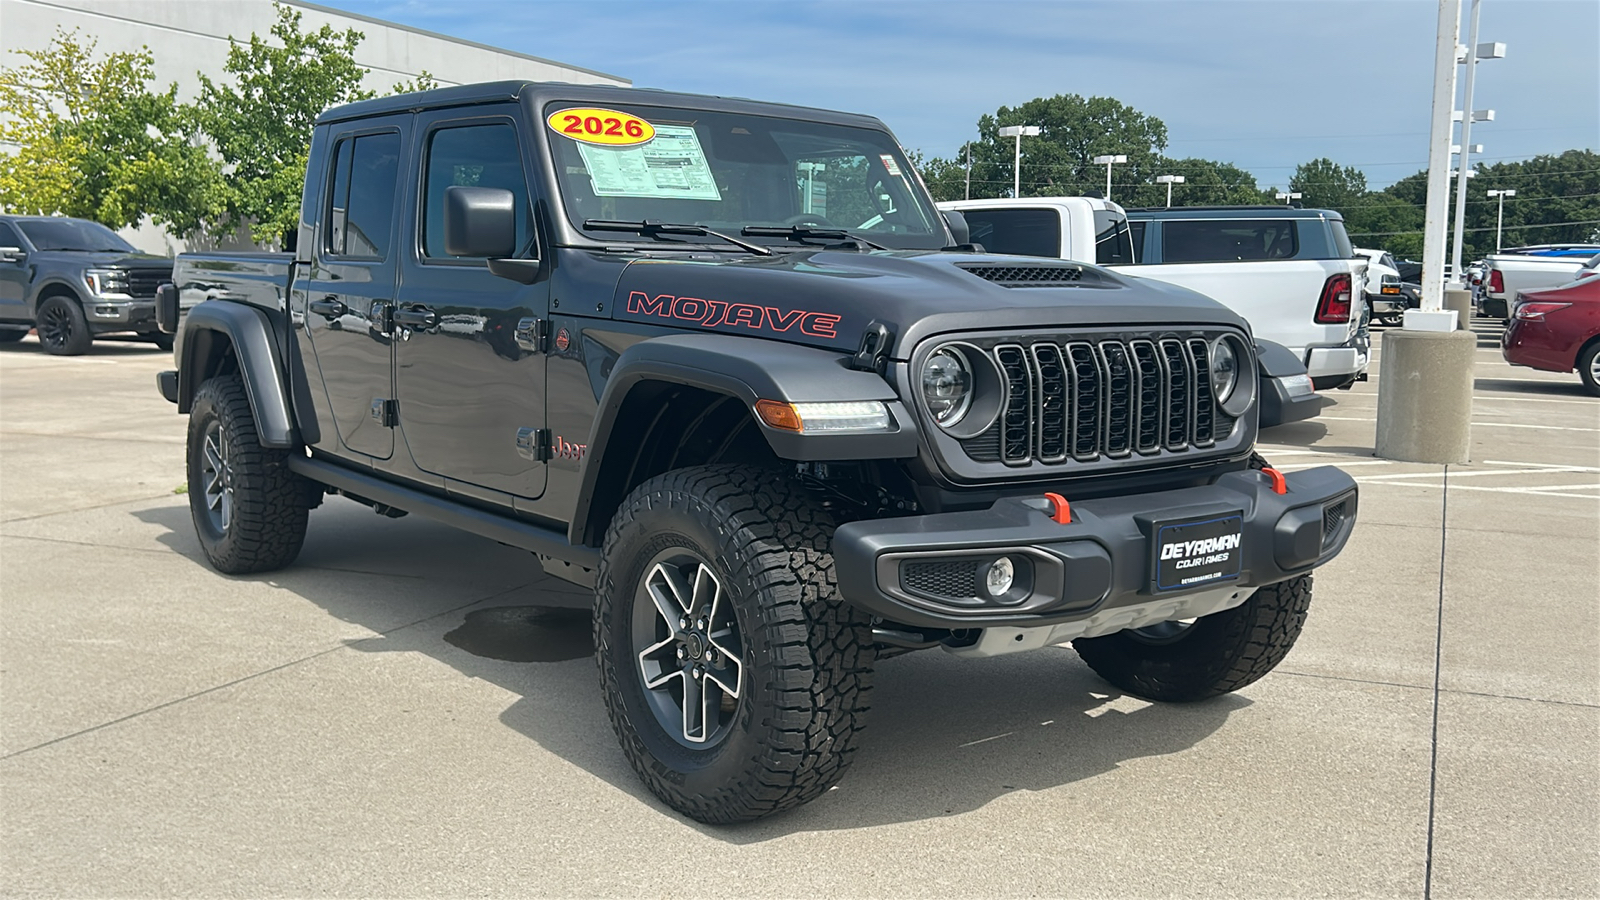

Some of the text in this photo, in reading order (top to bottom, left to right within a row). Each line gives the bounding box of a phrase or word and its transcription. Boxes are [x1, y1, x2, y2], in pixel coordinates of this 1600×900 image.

[563, 115, 643, 138] 2026
[627, 291, 842, 339] MOJAVE
[1160, 533, 1241, 560] DEYARMAN
